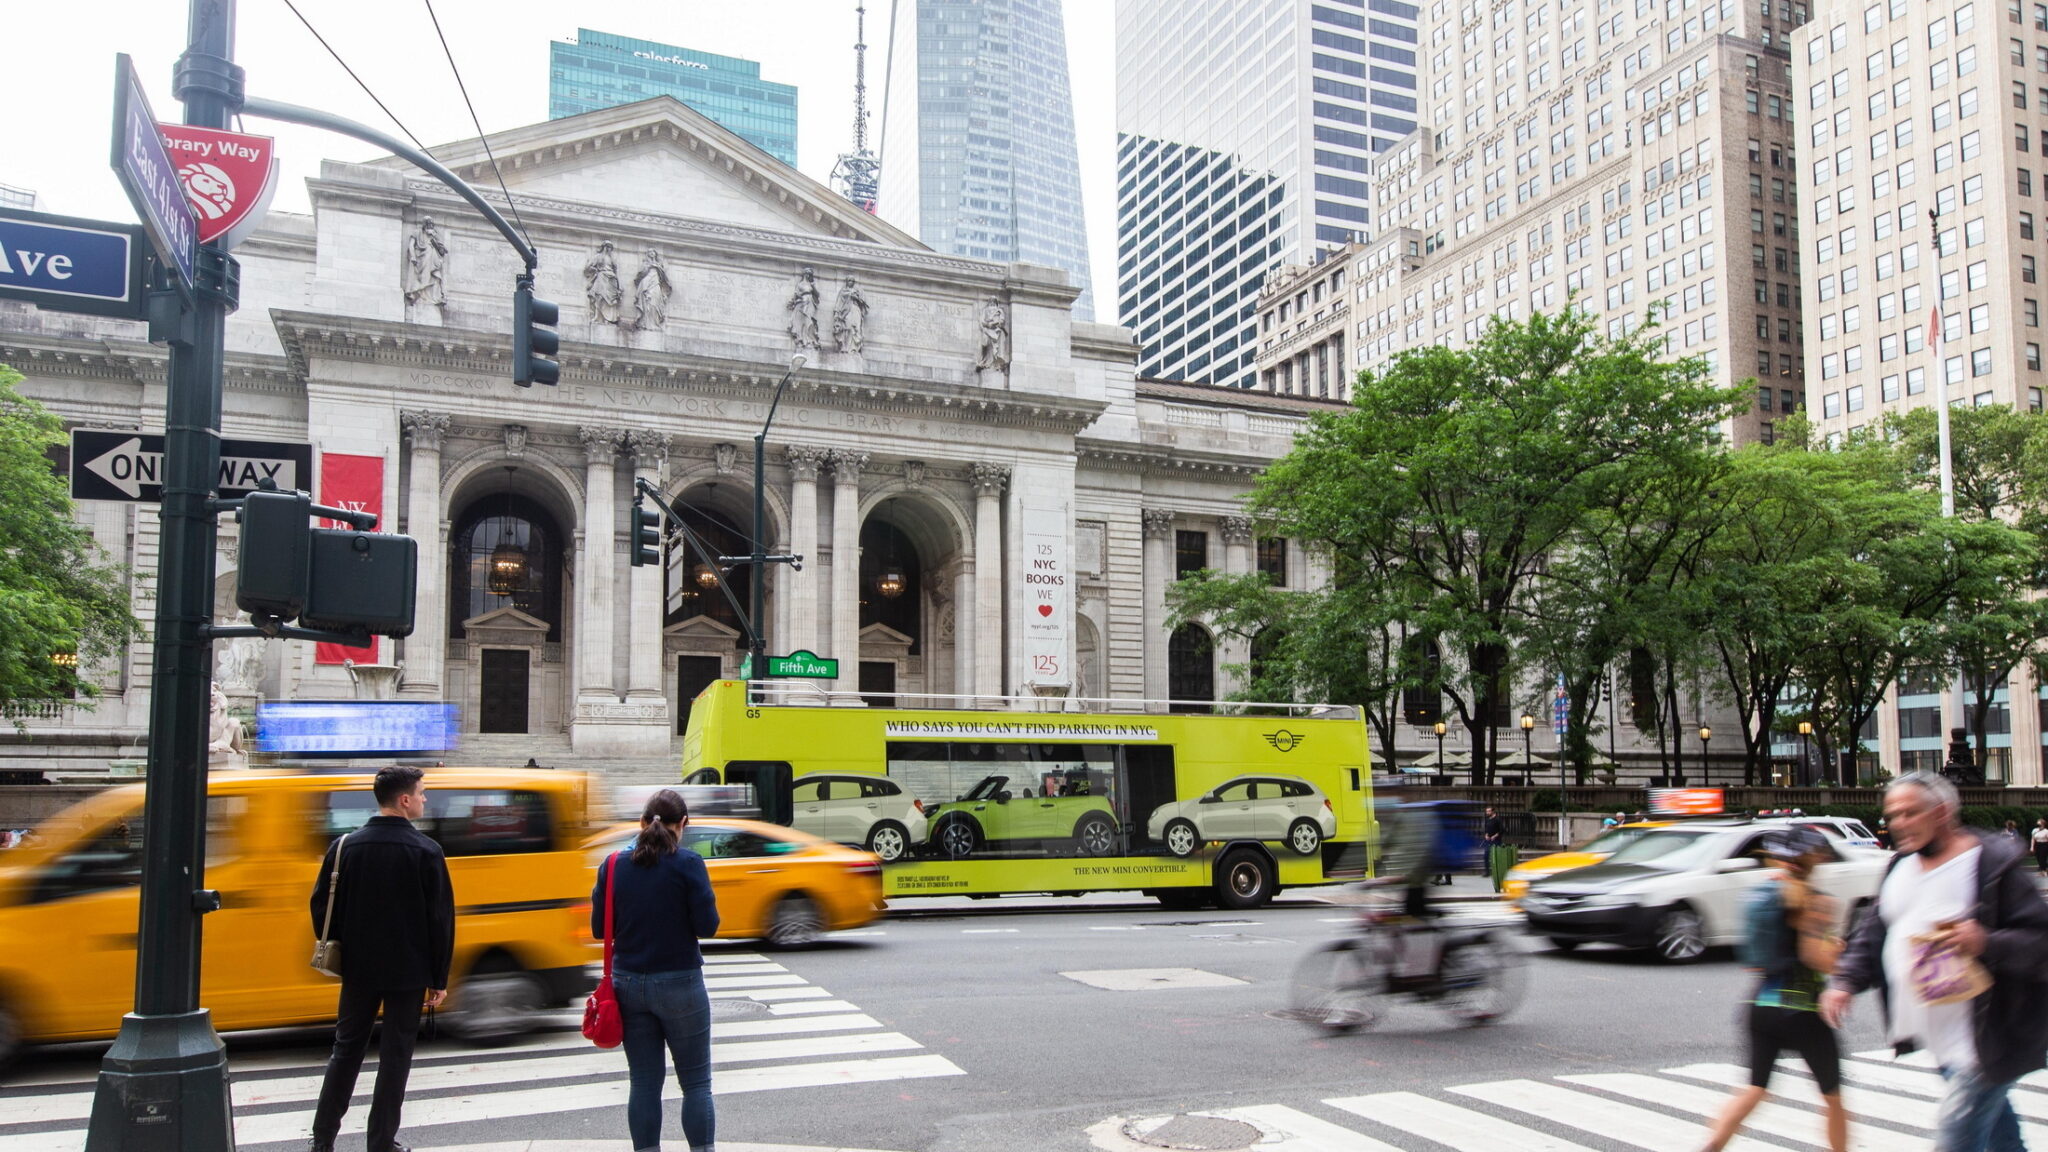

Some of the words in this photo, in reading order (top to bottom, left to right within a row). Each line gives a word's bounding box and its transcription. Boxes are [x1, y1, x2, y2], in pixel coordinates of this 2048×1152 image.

[163, 133, 213, 157] brary
[218, 140, 260, 163] Way
[133, 112, 157, 199] East
[159, 176, 178, 242] 41st
[180, 216, 190, 265] St
[410, 373, 495, 390] MDCCCXCV
[602, 390, 656, 407] NEW
[673, 396, 727, 416] YORK
[827, 412, 904, 432] LIBRARY
[111, 454, 164, 481] ON
[1037, 544, 1053, 556] 125
[1034, 559, 1056, 571] NYC
[1026, 573, 1064, 586] BOOKS
[1037, 589, 1053, 600] WE
[779, 662, 804, 674] Fifth
[806, 663, 827, 674] Ave
[1033, 655, 1059, 676] 125
[746, 709, 761, 719] G5
[886, 720, 920, 732] WHO
[922, 721, 954, 732] SAYS
[957, 722, 983, 733] YOU
[986, 722, 1022, 733] CAN'T
[1025, 723, 1055, 734] FIND
[1059, 724, 1111, 735] PARKING
[1115, 725, 1127, 735] IN
[1130, 725, 1156, 736] NYC.
[1073, 867, 1090, 875] THE
[1092, 867, 1111, 875] NEW
[1112, 866, 1131, 874] MINI
[1133, 865, 1187, 874] CONVERTIBLE.
